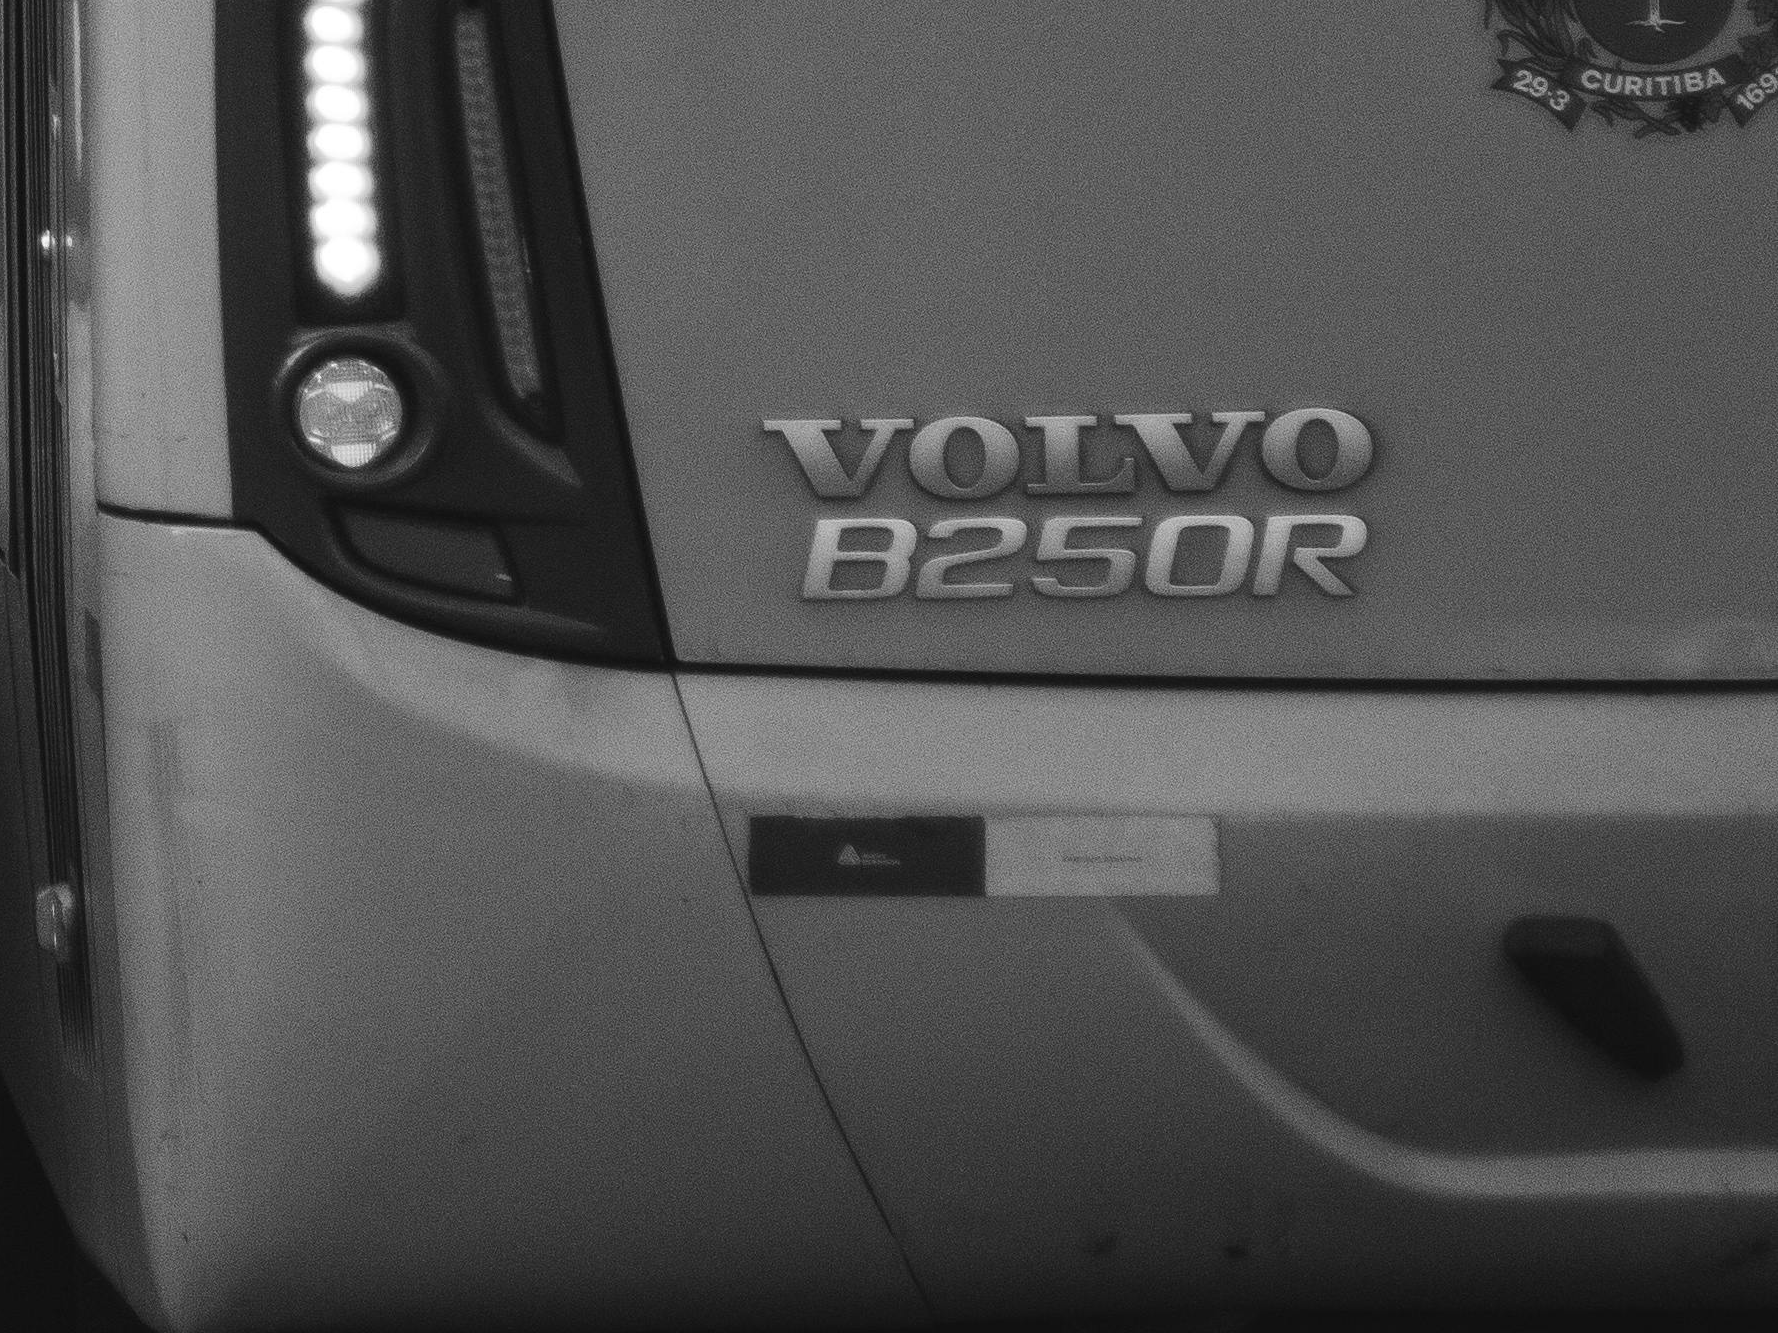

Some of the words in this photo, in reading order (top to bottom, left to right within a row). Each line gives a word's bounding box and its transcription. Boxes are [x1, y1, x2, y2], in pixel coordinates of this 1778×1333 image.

[1580, 68, 1726, 96] CURITIBA
[762, 407, 1374, 500] VOLVO
[802, 514, 1368, 599] B250R
